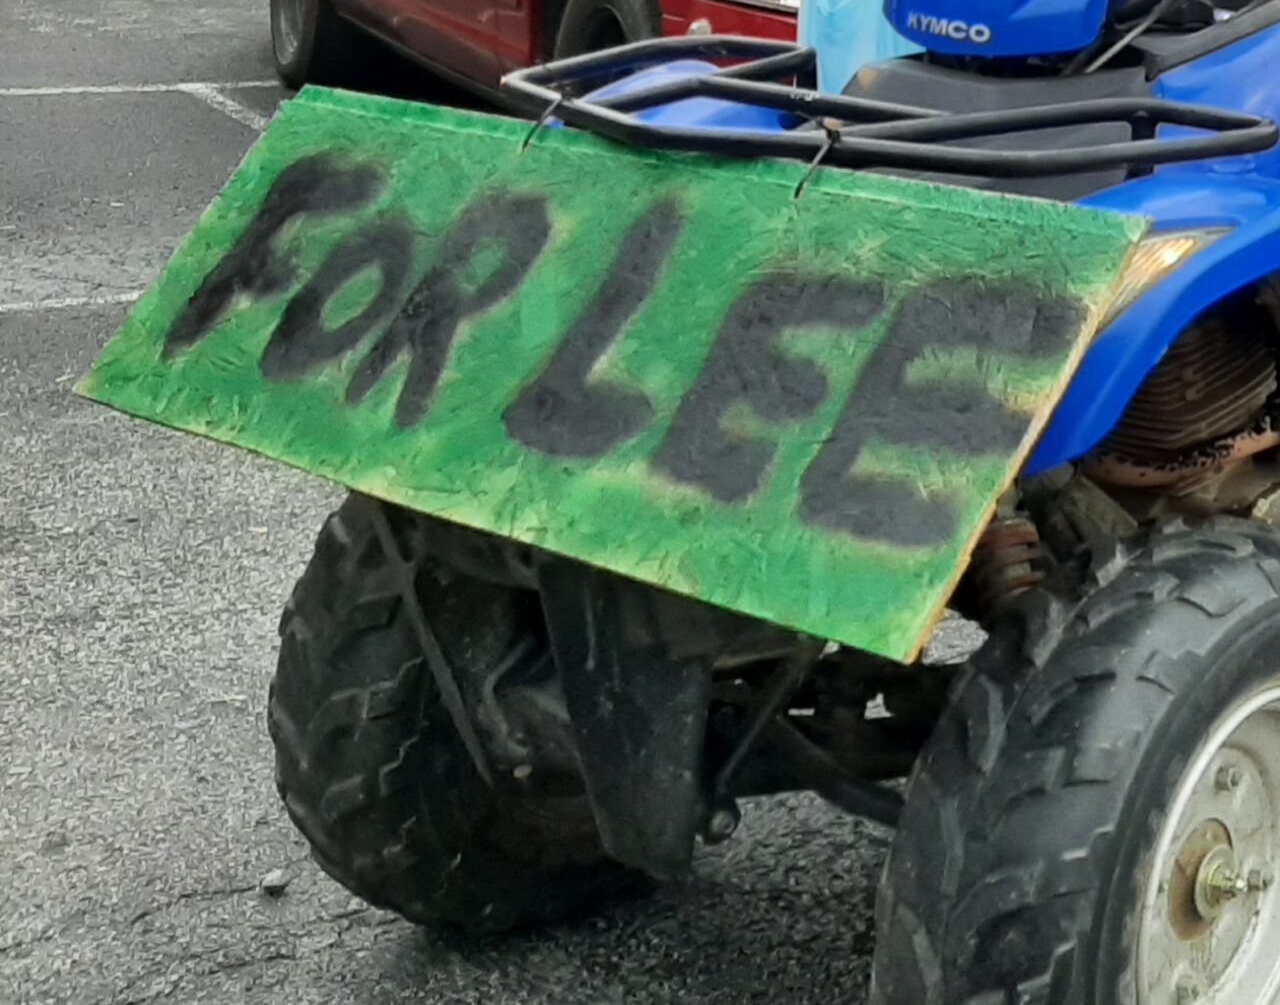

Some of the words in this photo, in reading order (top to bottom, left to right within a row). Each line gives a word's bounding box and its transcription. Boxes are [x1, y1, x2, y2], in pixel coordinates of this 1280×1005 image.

[907, 12, 992, 43] KYMCO
[162, 151, 548, 428] FOR
[500, 194, 1086, 548] LEE
